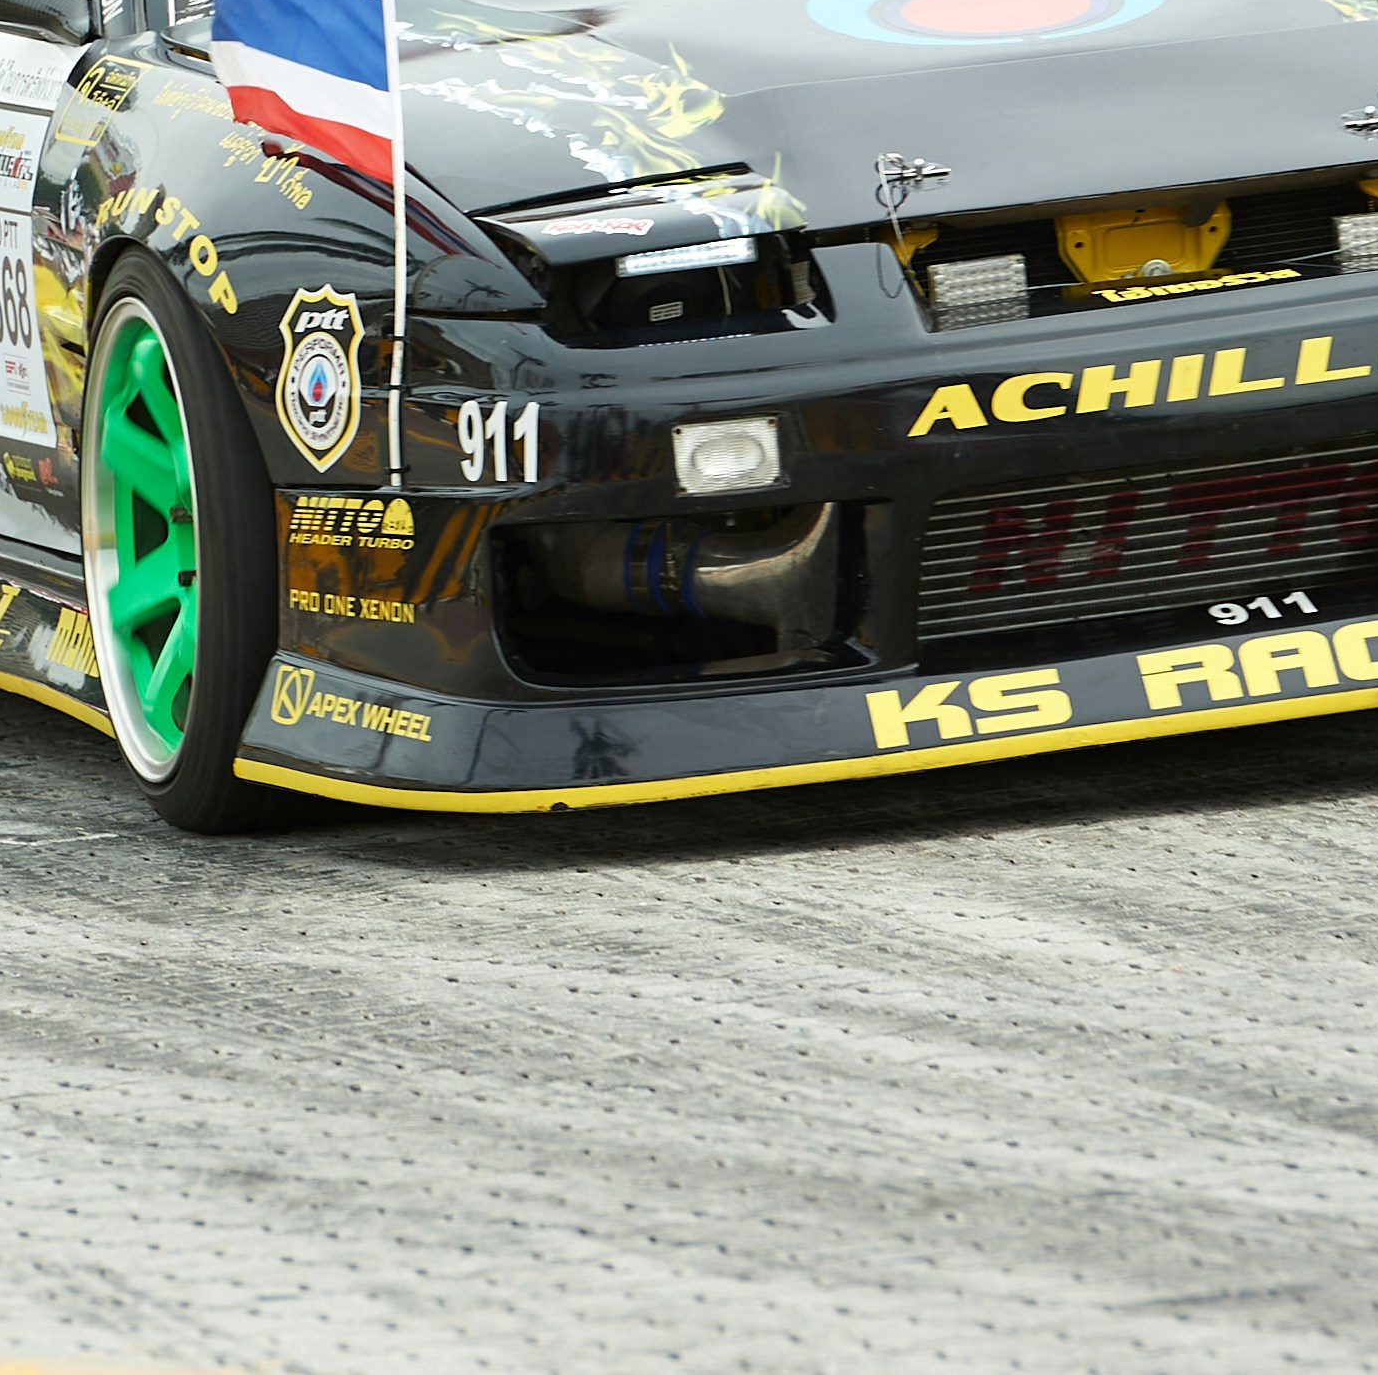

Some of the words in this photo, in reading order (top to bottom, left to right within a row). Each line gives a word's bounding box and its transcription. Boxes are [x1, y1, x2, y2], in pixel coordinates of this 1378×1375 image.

[3, 219, 19, 250] PTT
[94, 186, 161, 228] RUN
[155, 196, 239, 316] STOP
[293, 308, 350, 334] ptt
[457, 399, 541, 484] 911
[289, 496, 385, 534] NITTO
[289, 532, 352, 547] HEADER
[358, 536, 416, 550] TURBO
[289, 588, 321, 613] PRO
[324, 593, 356, 617] ONE
[359, 597, 415, 624] XENON
[1207, 590, 1320, 626] 911
[306, 691, 363, 727] APEX
[361, 703, 433, 743] WHEEL
[865, 667, 1074, 751] KS
